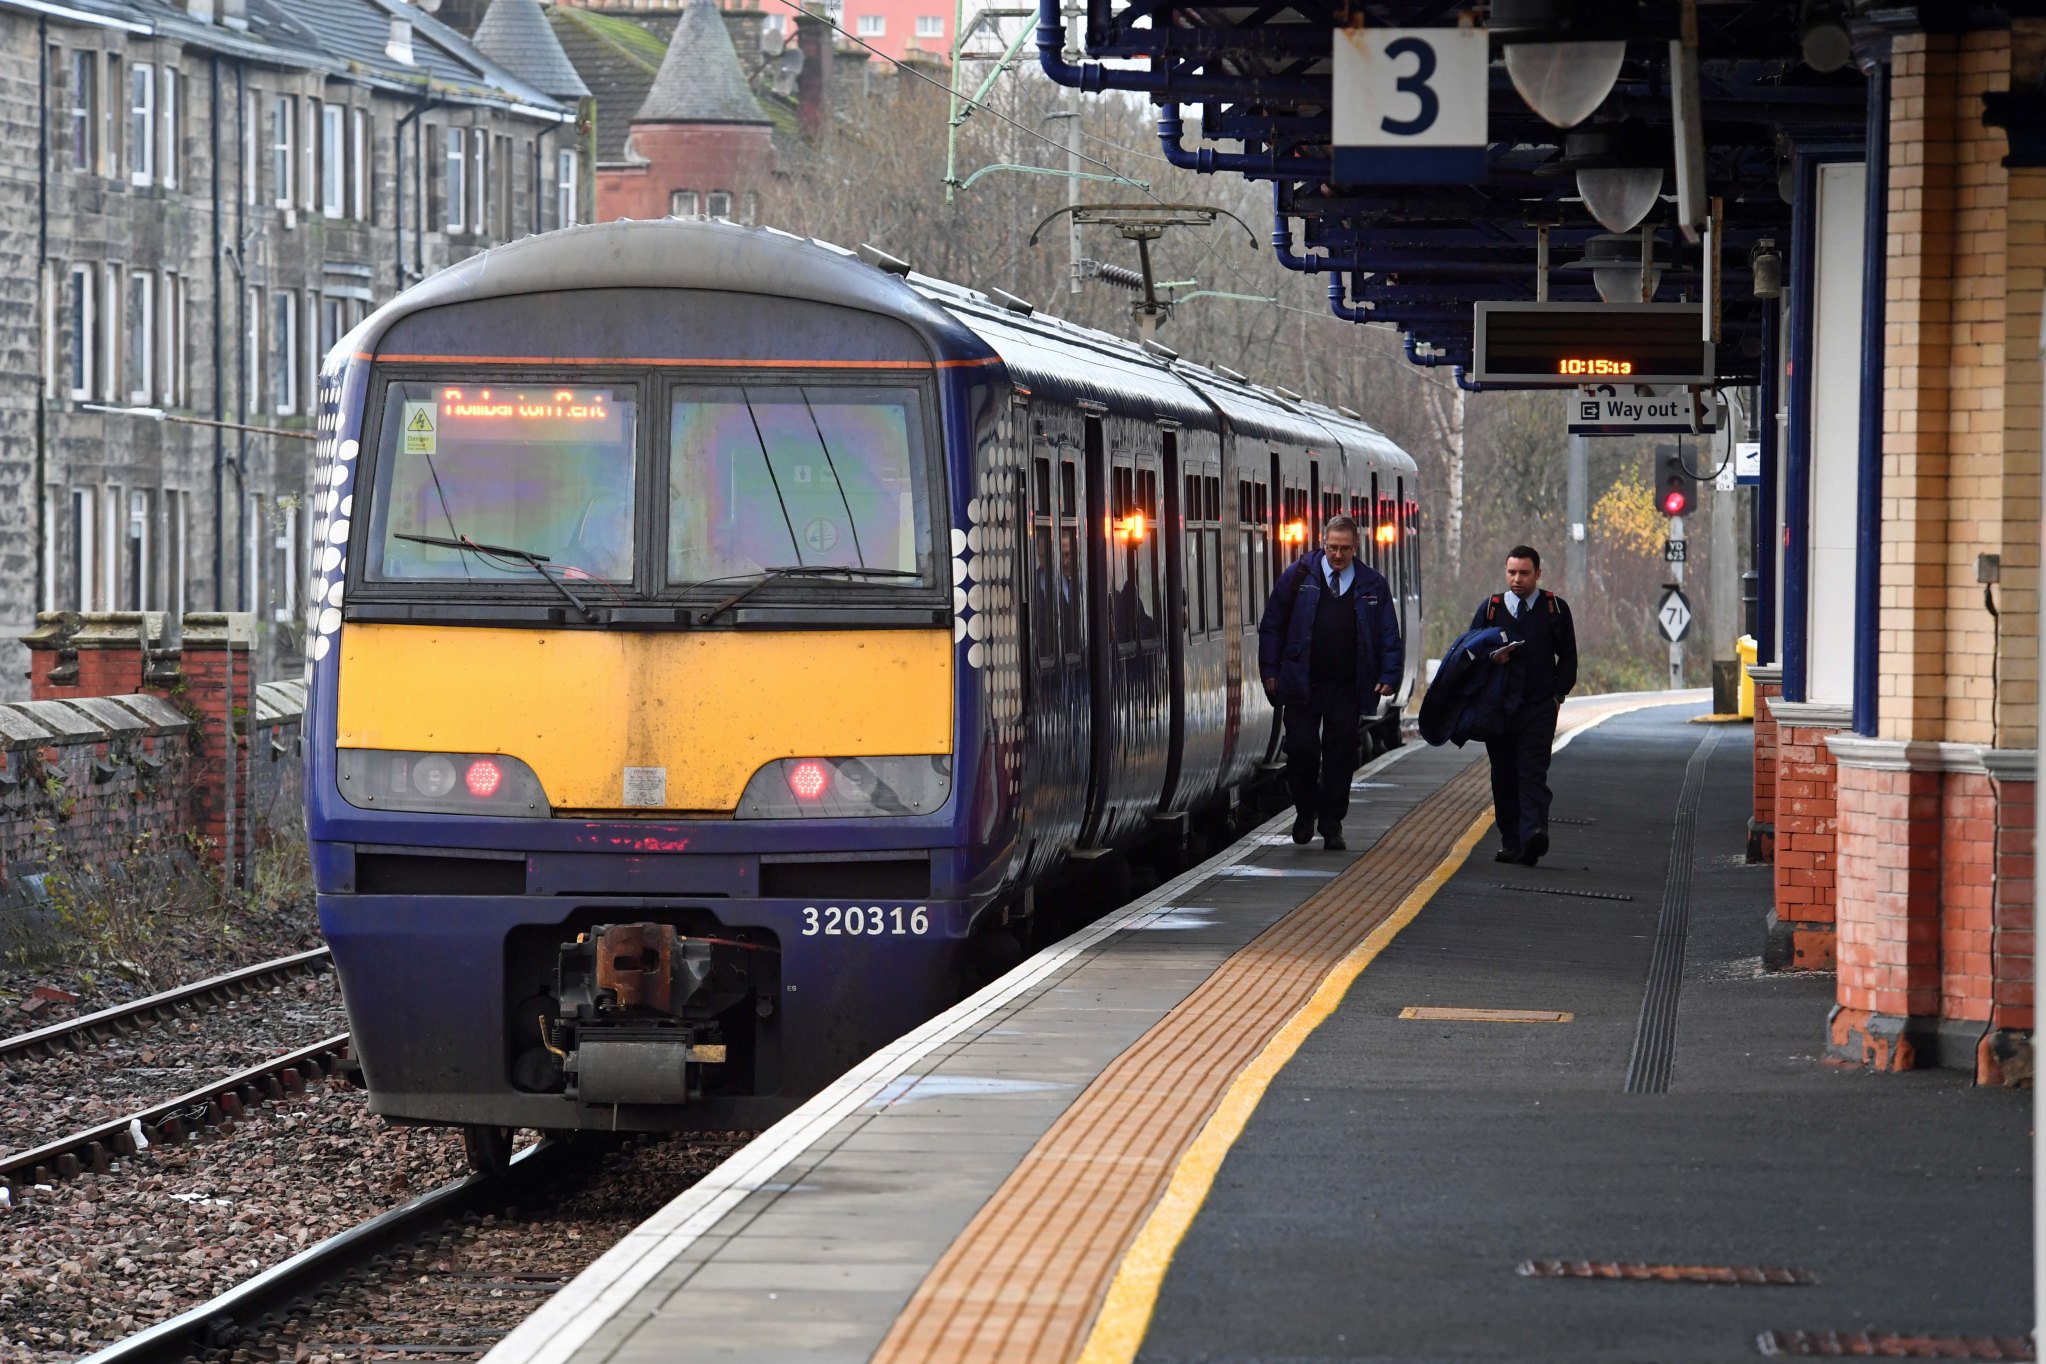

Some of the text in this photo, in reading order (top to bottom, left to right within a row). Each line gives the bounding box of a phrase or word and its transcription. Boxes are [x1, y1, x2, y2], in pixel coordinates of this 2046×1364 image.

[1380, 36, 1440, 136] 3
[1560, 359, 1631, 374] 10:15:13
[1607, 401, 1678, 421] Way out
[1666, 607, 1683, 625] 71
[801, 906, 929, 936] 320316
